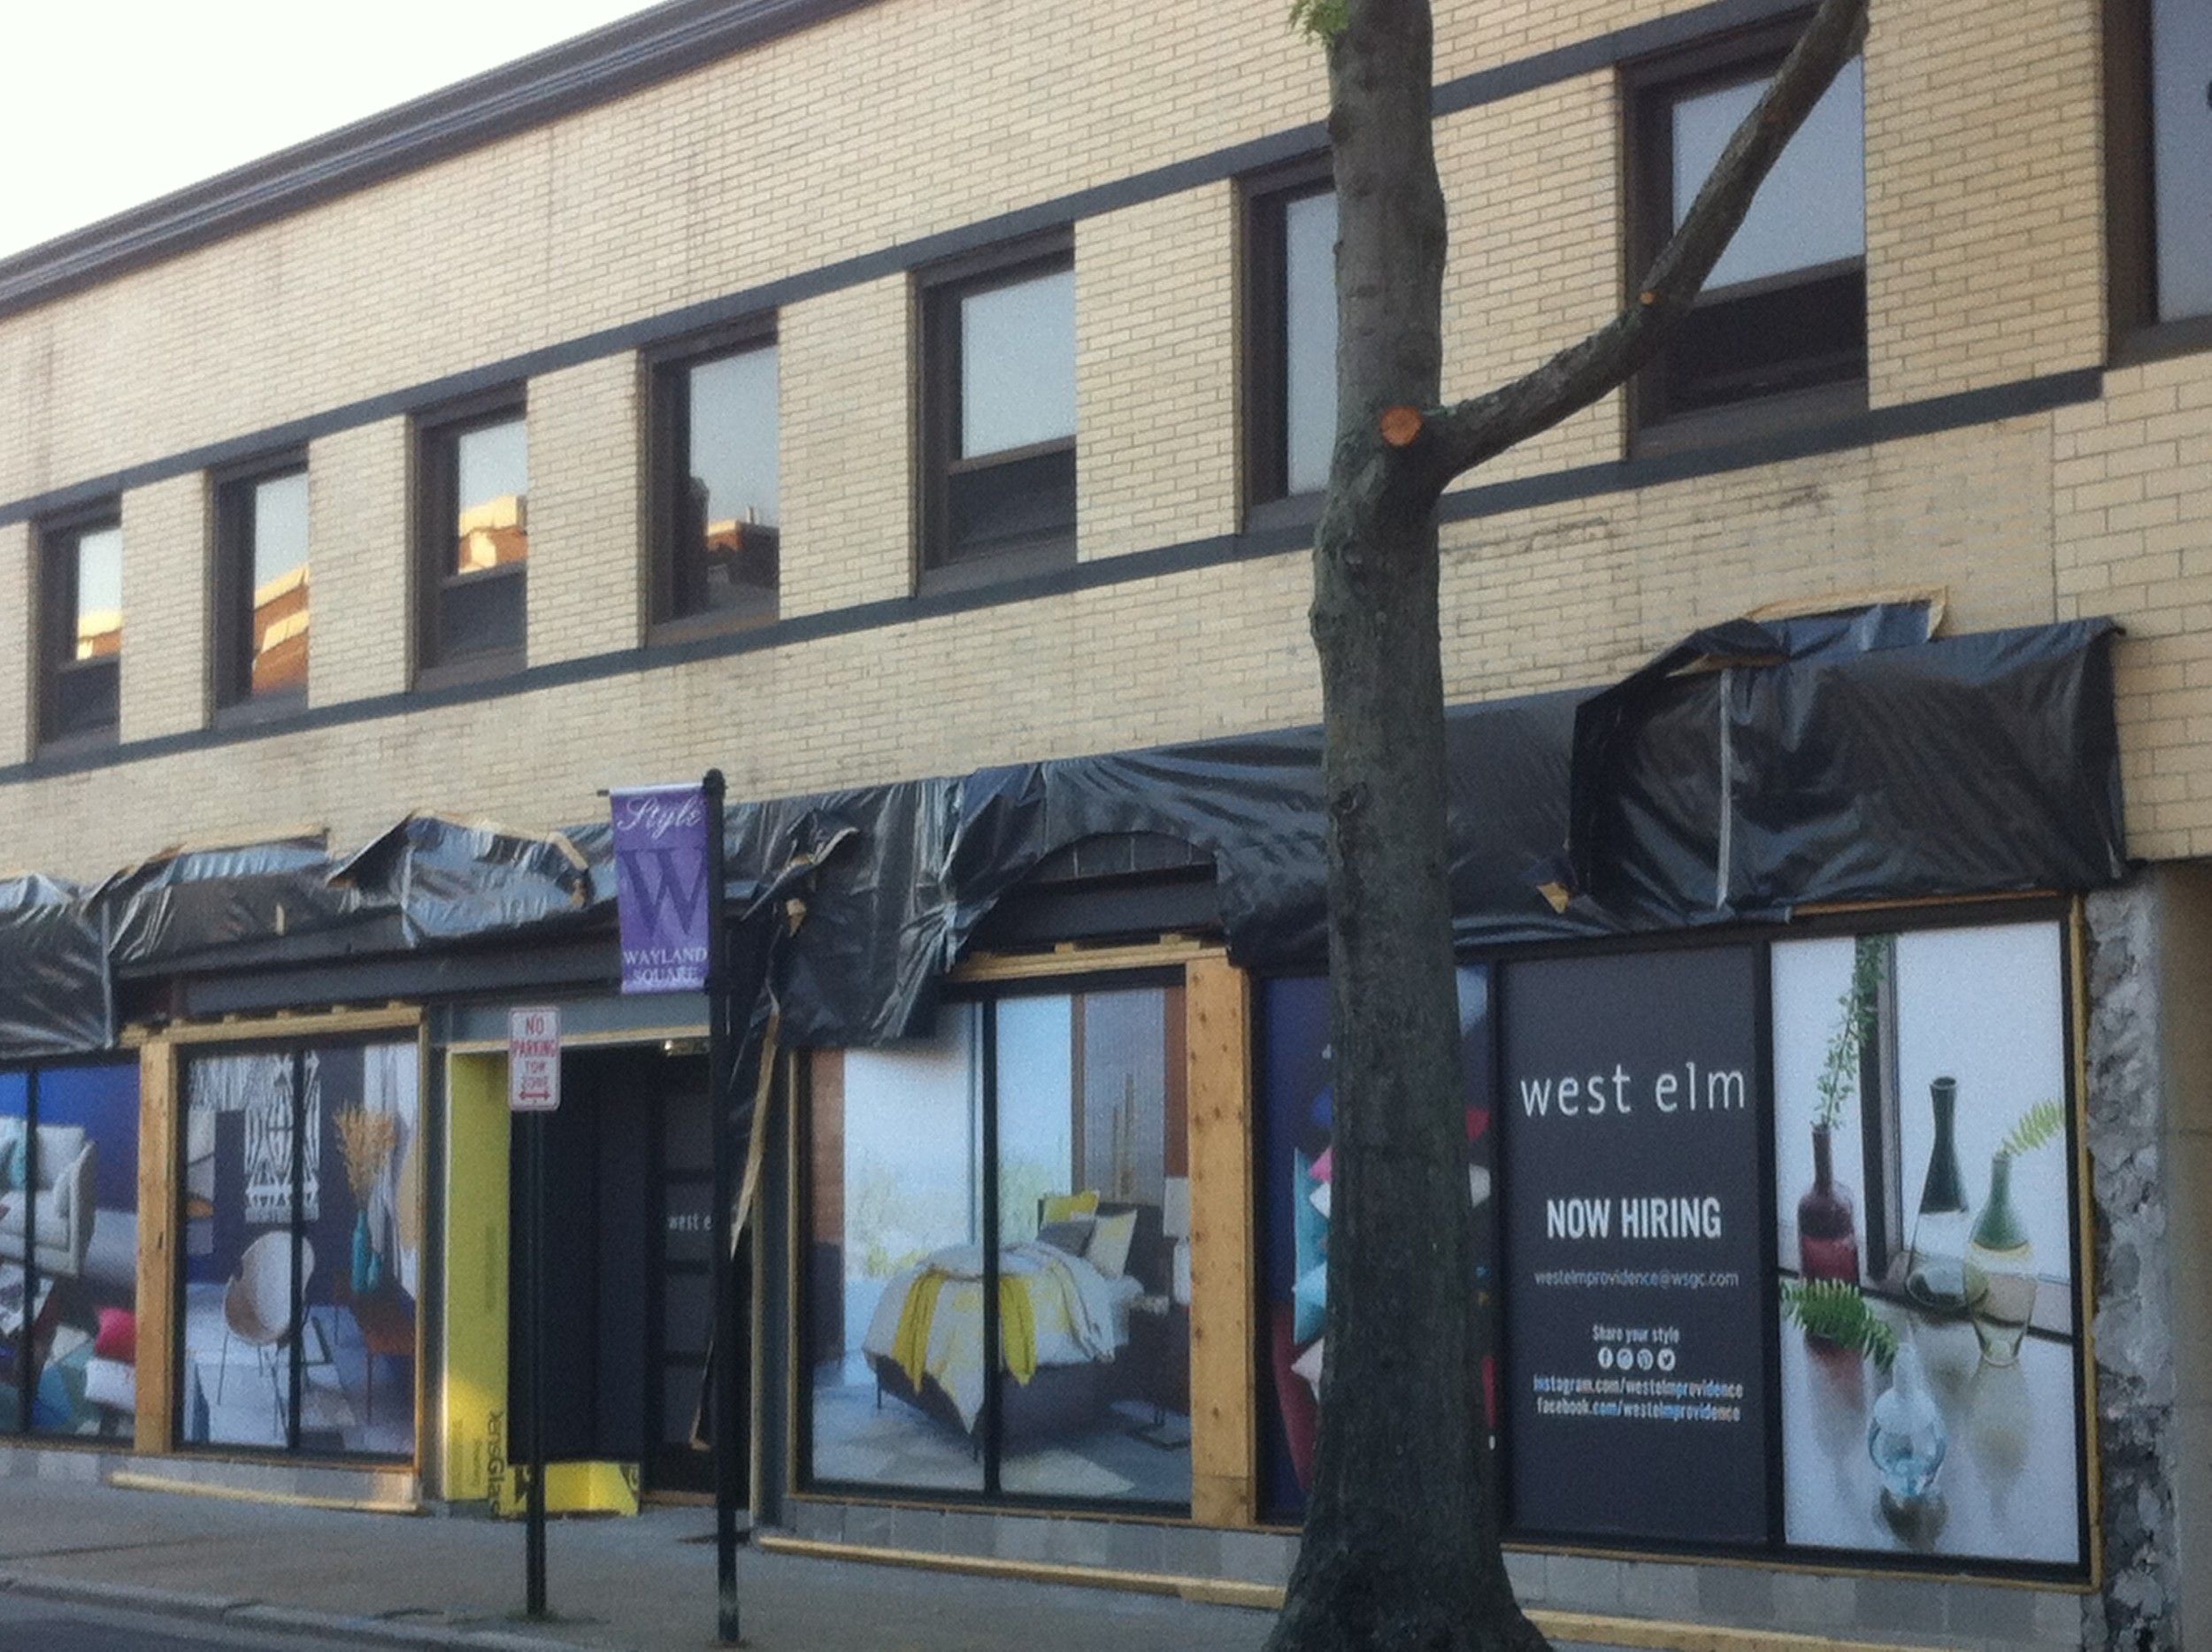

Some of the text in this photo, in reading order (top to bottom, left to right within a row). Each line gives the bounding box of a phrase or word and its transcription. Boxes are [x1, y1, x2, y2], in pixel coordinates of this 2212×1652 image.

[618, 796, 702, 839] Style
[623, 948, 708, 964] WAYLAND
[634, 964, 699, 984] SQUARE
[526, 1015, 545, 1035] NO
[512, 1039, 557, 1057] PARKING
[1521, 1061, 1745, 1117] west elm
[1548, 1196, 1721, 1239] NOW HIRING
[1592, 1325, 1679, 1345] Share your style
